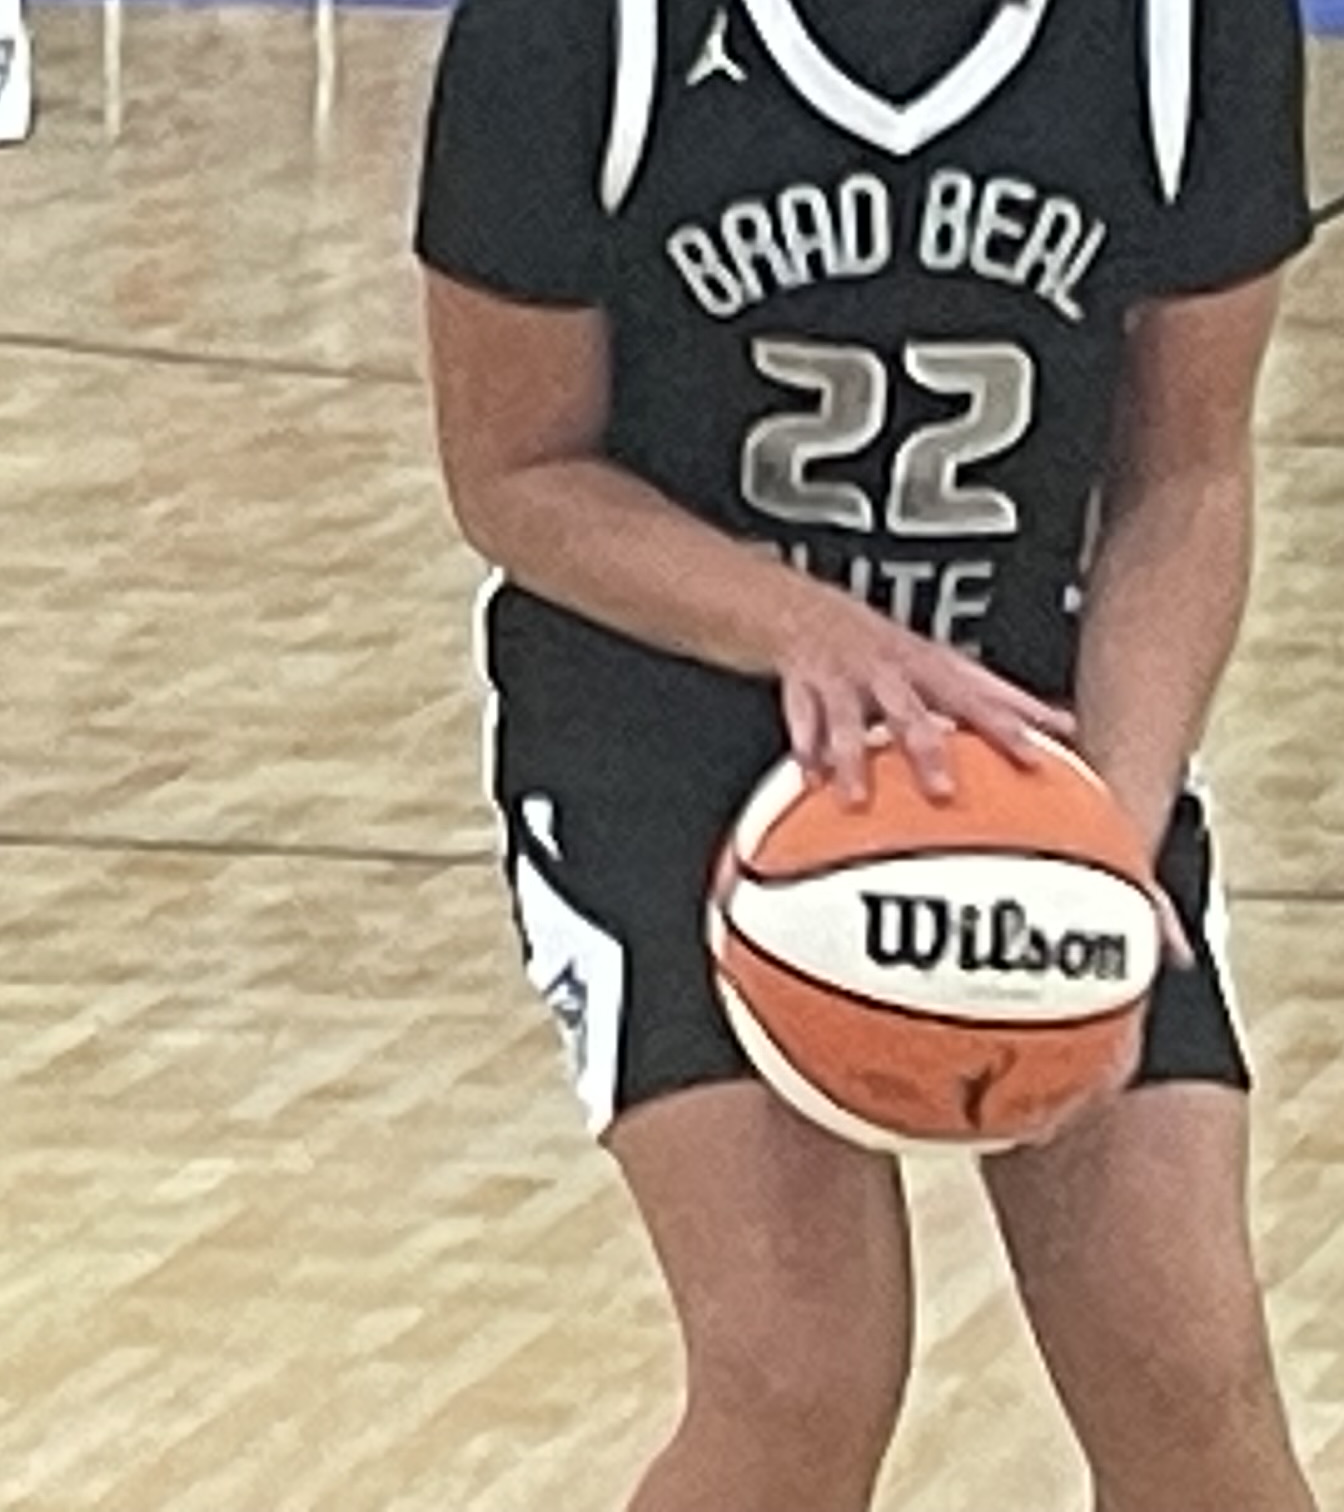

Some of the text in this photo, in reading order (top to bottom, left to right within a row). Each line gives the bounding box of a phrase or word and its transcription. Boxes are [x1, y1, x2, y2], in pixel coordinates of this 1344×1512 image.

[665, 168, 1107, 321] BRAD BEAL
[740, 336, 1035, 537] 22
[858, 890, 1128, 982] Wilson
